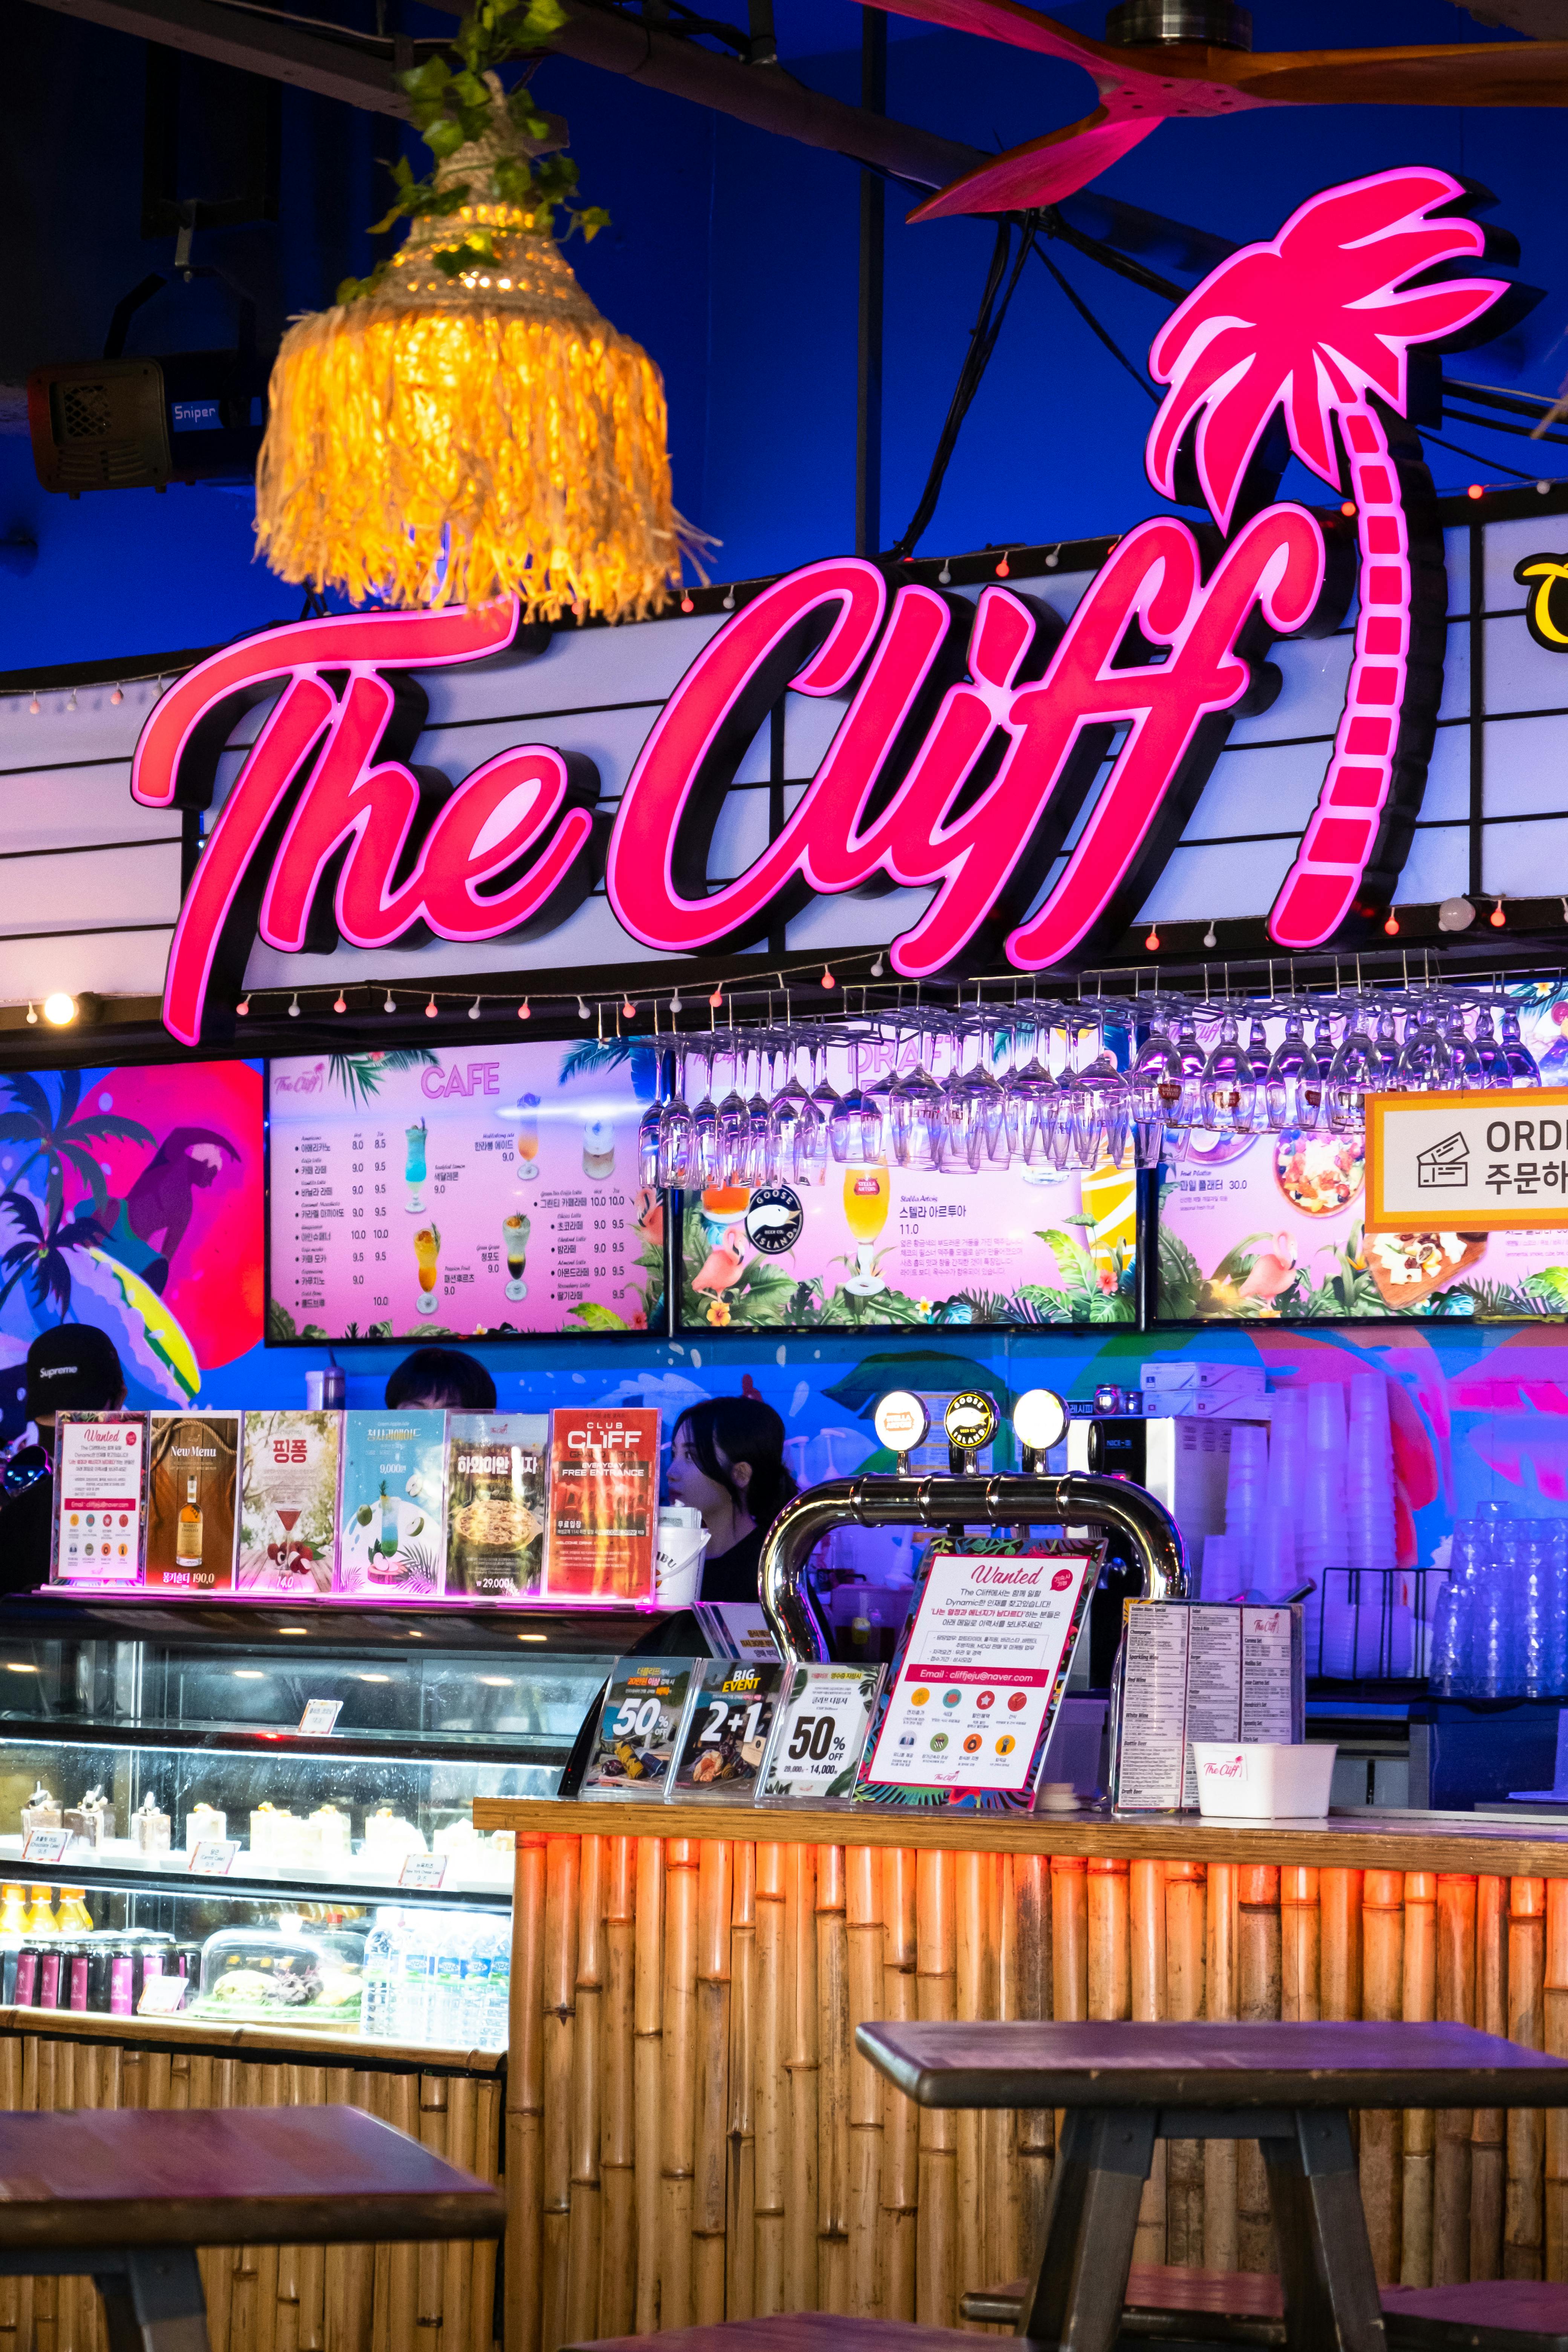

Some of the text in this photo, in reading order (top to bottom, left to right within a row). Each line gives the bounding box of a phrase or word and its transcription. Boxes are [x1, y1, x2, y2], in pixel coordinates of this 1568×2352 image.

[175, 406, 216, 423] Sniper
[131, 502, 1326, 1047] The Cliff
[421, 1062, 500, 1099] CAFE
[1486, 1119, 1568, 1153] ORD
[302, 1139, 386, 1153] 아메리카노 8.0 8.5
[502, 1152, 514, 1162] 9.0
[352, 1163, 363, 1172] 9.0
[375, 1162, 386, 1171] 9.5
[1485, 1160, 1568, 1195] 주문하
[302, 1188, 319, 1196] 바닐라
[352, 1185, 363, 1194] 9.0
[375, 1184, 386, 1194] 9.5
[434, 1185, 445, 1194] 9.0
[1229, 1180, 1248, 1190] 30.0
[591, 1197, 606, 1206] 10.0
[609, 1196, 625, 1205] 10.0
[756, 1188, 794, 1205] GOOSE
[352, 1208, 363, 1217] 9.0
[375, 1207, 386, 1216] 9.5
[899, 1205, 966, 1218] 스텔라 아르투아
[557, 1219, 624, 1231] 초코라떼 9.0 9.5
[900, 1224, 919, 1234] 11.0
[351, 1230, 366, 1239] 10.0
[374, 1229, 388, 1239] 10.0
[755, 1230, 794, 1250] ISLAND
[594, 1243, 606, 1253] 9.0
[612, 1242, 624, 1252] 9.5
[315, 1254, 326, 1263] 모카
[352, 1252, 364, 1262] 9.5
[375, 1251, 386, 1261] 9.5
[481, 1253, 499, 1262] 청포도
[488, 1264, 499, 1273] 9.0
[557, 1266, 624, 1277] 아몬드라떼 9.0 9.5
[352, 1275, 364, 1284] 9.0
[444, 1286, 455, 1295] 9.0
[557, 1289, 625, 1301] 딸기라떼 9.5
[374, 1296, 388, 1306] 10.0
[40, 1366, 78, 1379] Supreme
[954, 1396, 984, 1409] GOOSE
[84, 1429, 120, 1442] Wanted
[953, 1429, 985, 1444] ISLAND
[171, 1446, 217, 1457] New Menu
[273, 1439, 308, 1464] 핑퐁
[458, 1455, 510, 1475] 하와이안
[557, 1520, 582, 1529] 무료입장
[971, 1565, 1044, 1585] Wanted
[277, 1576, 294, 1588] 14.0
[975, 1589, 1011, 1597] Cliff에서는
[946, 1599, 986, 1607] Dynamic한
[969, 1609, 995, 1617] 에너지가
[733, 1669, 755, 1682] BIG
[920, 1669, 1033, 1682] Email cliffjeju@naver.com
[721, 1677, 761, 1693] EVENT
[700, 1700, 763, 1744] 2+1
[828, 1752, 844, 1761] OFF
[1204, 1762, 1240, 1778] The Cliff
